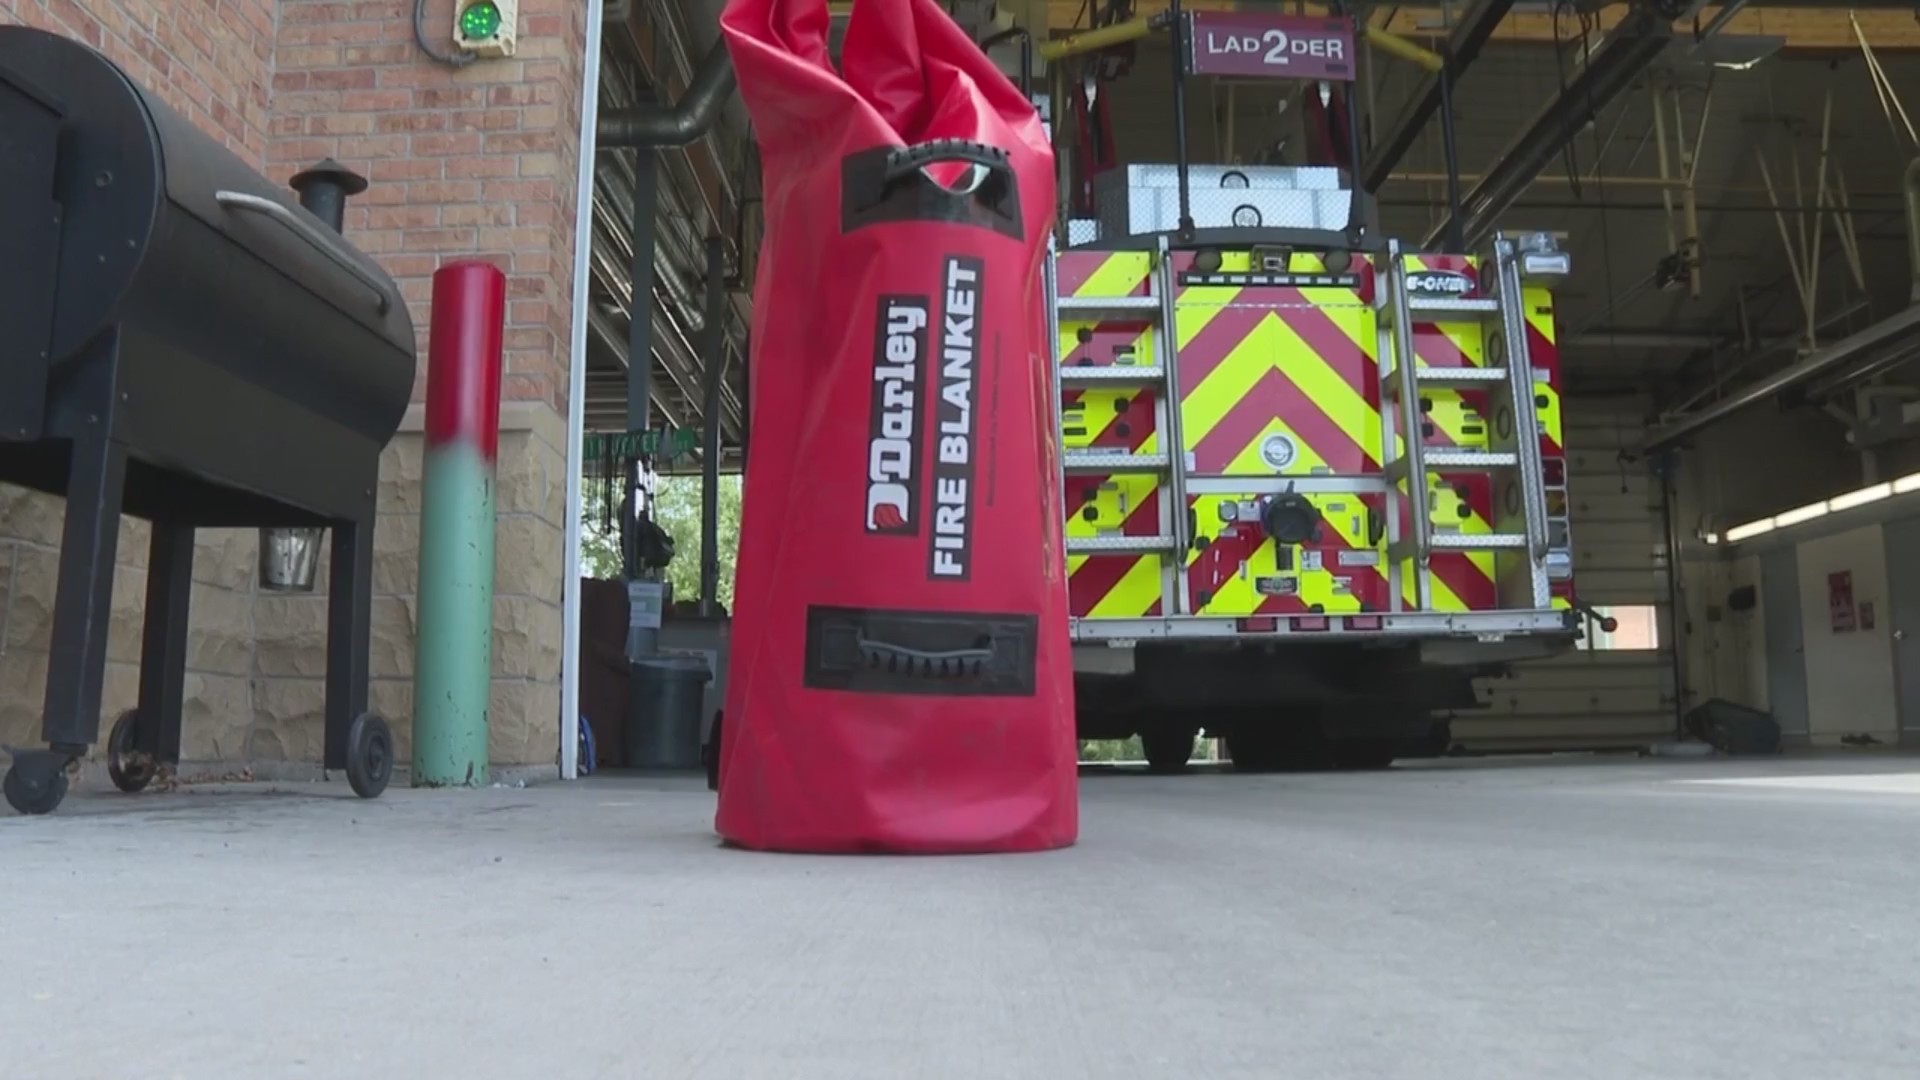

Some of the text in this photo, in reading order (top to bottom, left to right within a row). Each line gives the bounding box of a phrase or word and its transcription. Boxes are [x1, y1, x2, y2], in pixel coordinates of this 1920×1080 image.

[869, 305, 927, 483] Darley
[934, 259, 977, 576] FIRE BLANKET
